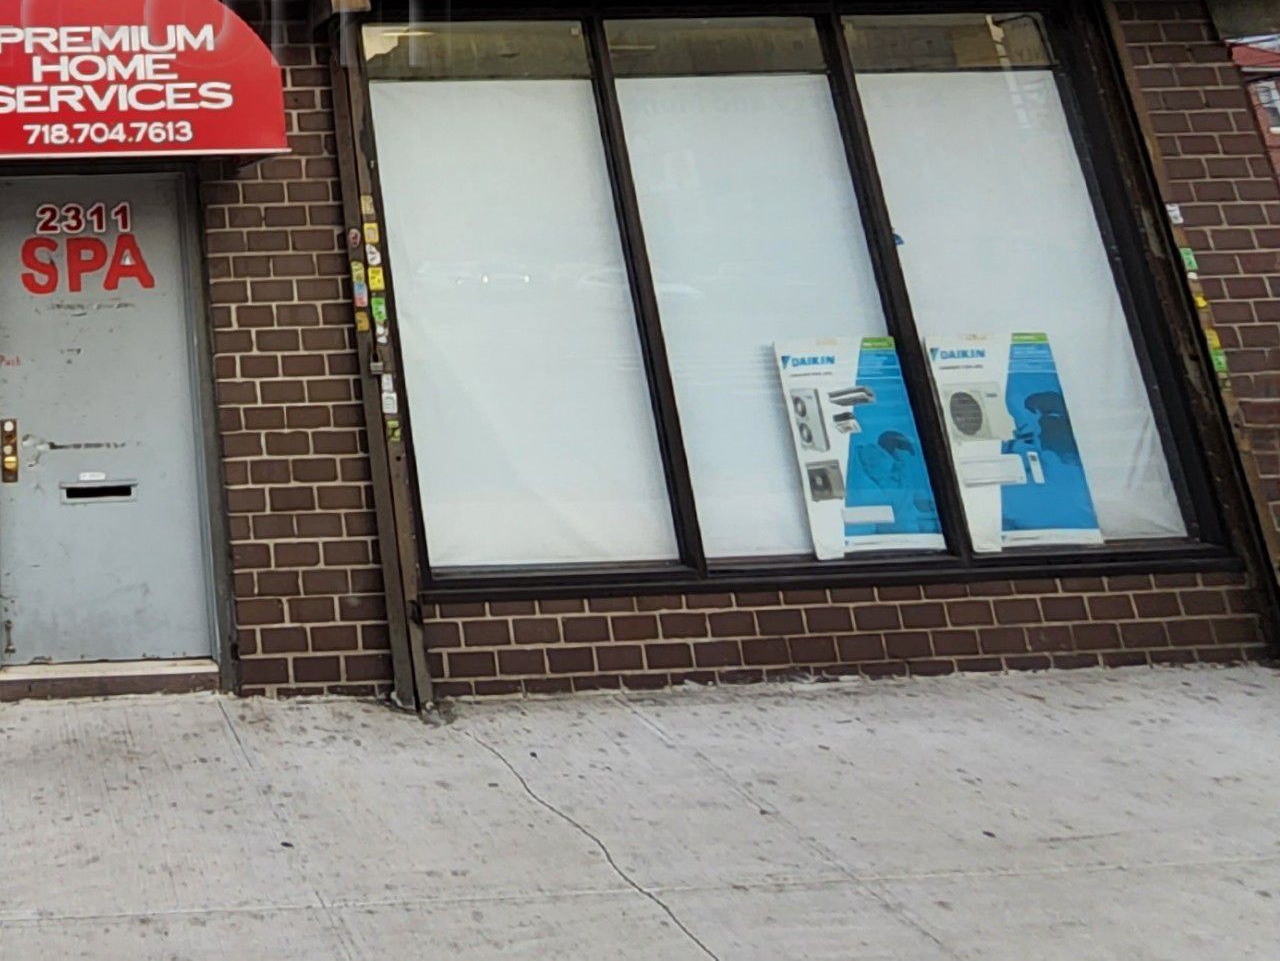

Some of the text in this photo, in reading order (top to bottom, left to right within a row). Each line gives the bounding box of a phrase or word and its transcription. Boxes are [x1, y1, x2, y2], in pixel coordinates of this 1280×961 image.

[32, 53, 179, 82] HOME
[23, 120, 193, 145] 718.704.7613
[35, 201, 132, 234] 2311
[20, 233, 155, 295] SPA
[791, 355, 836, 367] DAIKIN
[940, 349, 986, 359] DAIKIN
